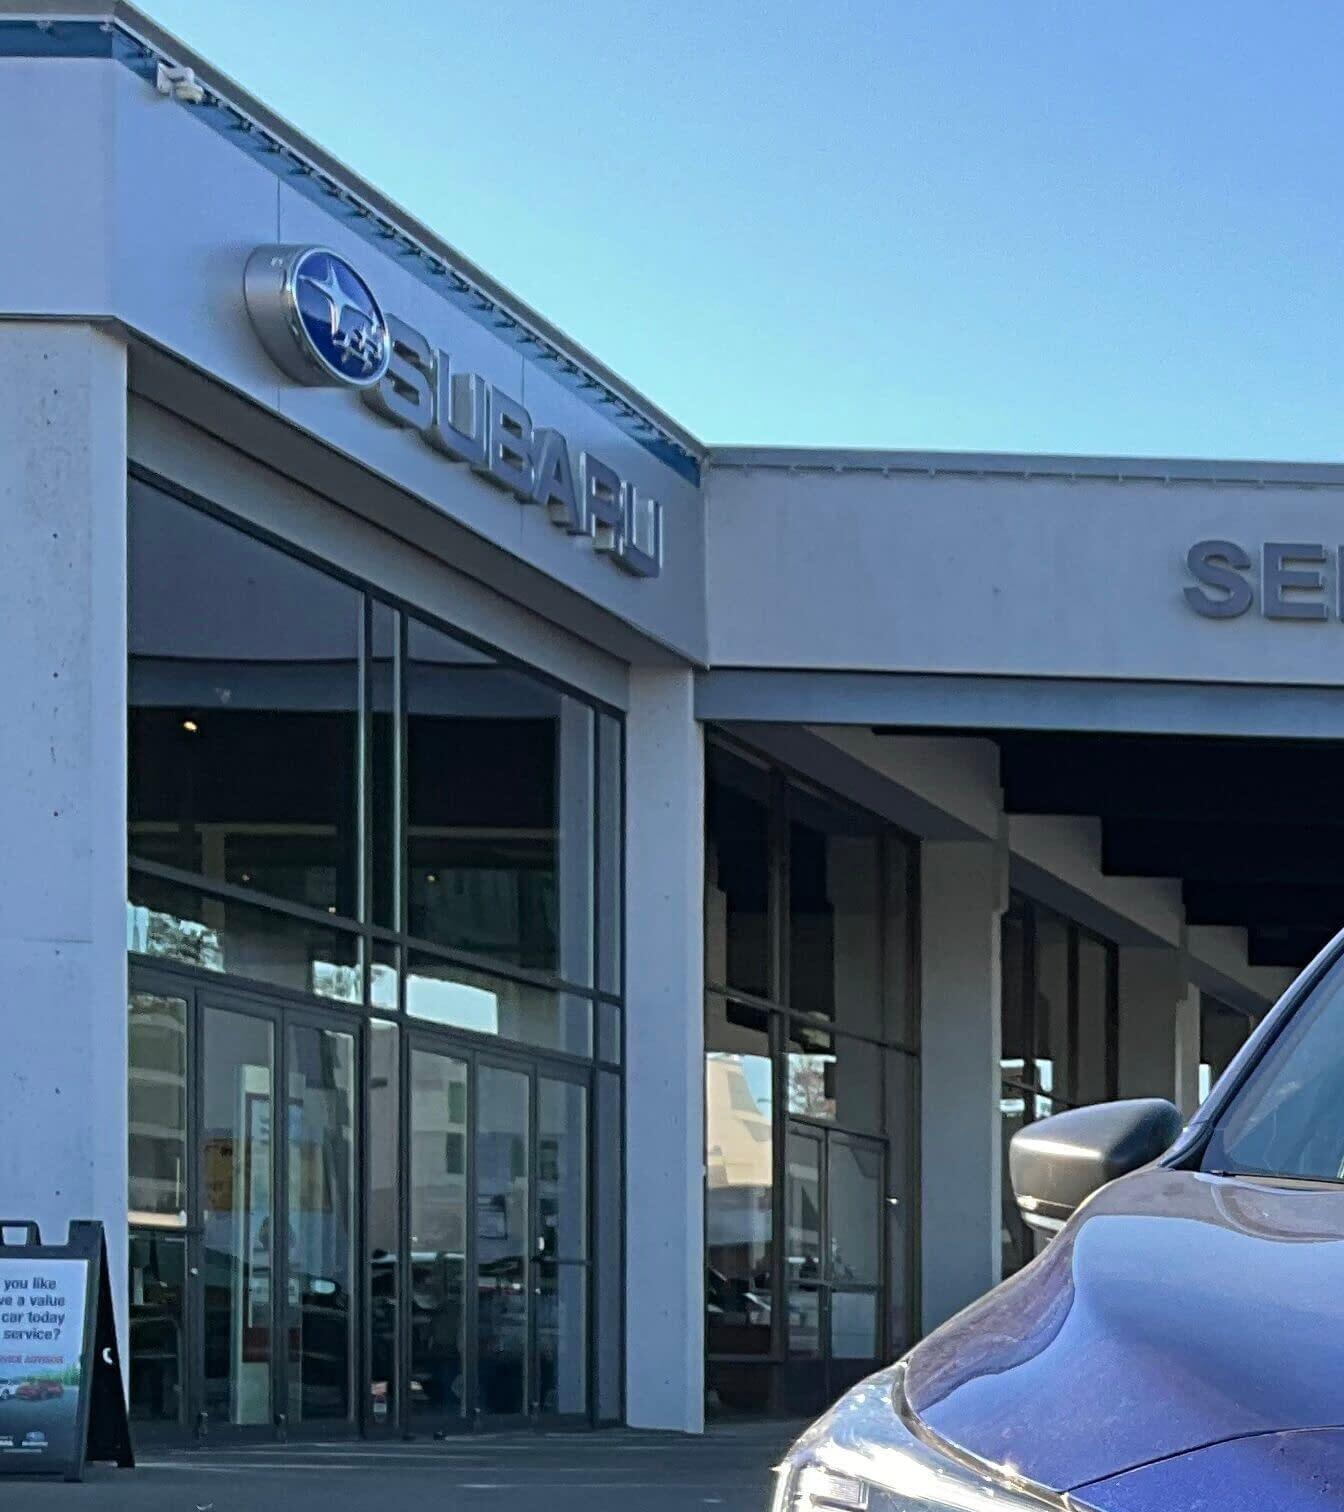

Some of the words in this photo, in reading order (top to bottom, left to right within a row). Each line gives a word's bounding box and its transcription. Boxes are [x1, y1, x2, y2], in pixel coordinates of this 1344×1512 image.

[370, 313, 663, 577] SUBARU
[4, 1279, 28, 1291] you
[32, 1277, 56, 1289] like
[17, 1297, 25, 1306] a
[30, 1295, 65, 1306] value
[2, 1312, 23, 1323] car
[27, 1311, 65, 1326] today
[3, 1328, 61, 1339] service?
